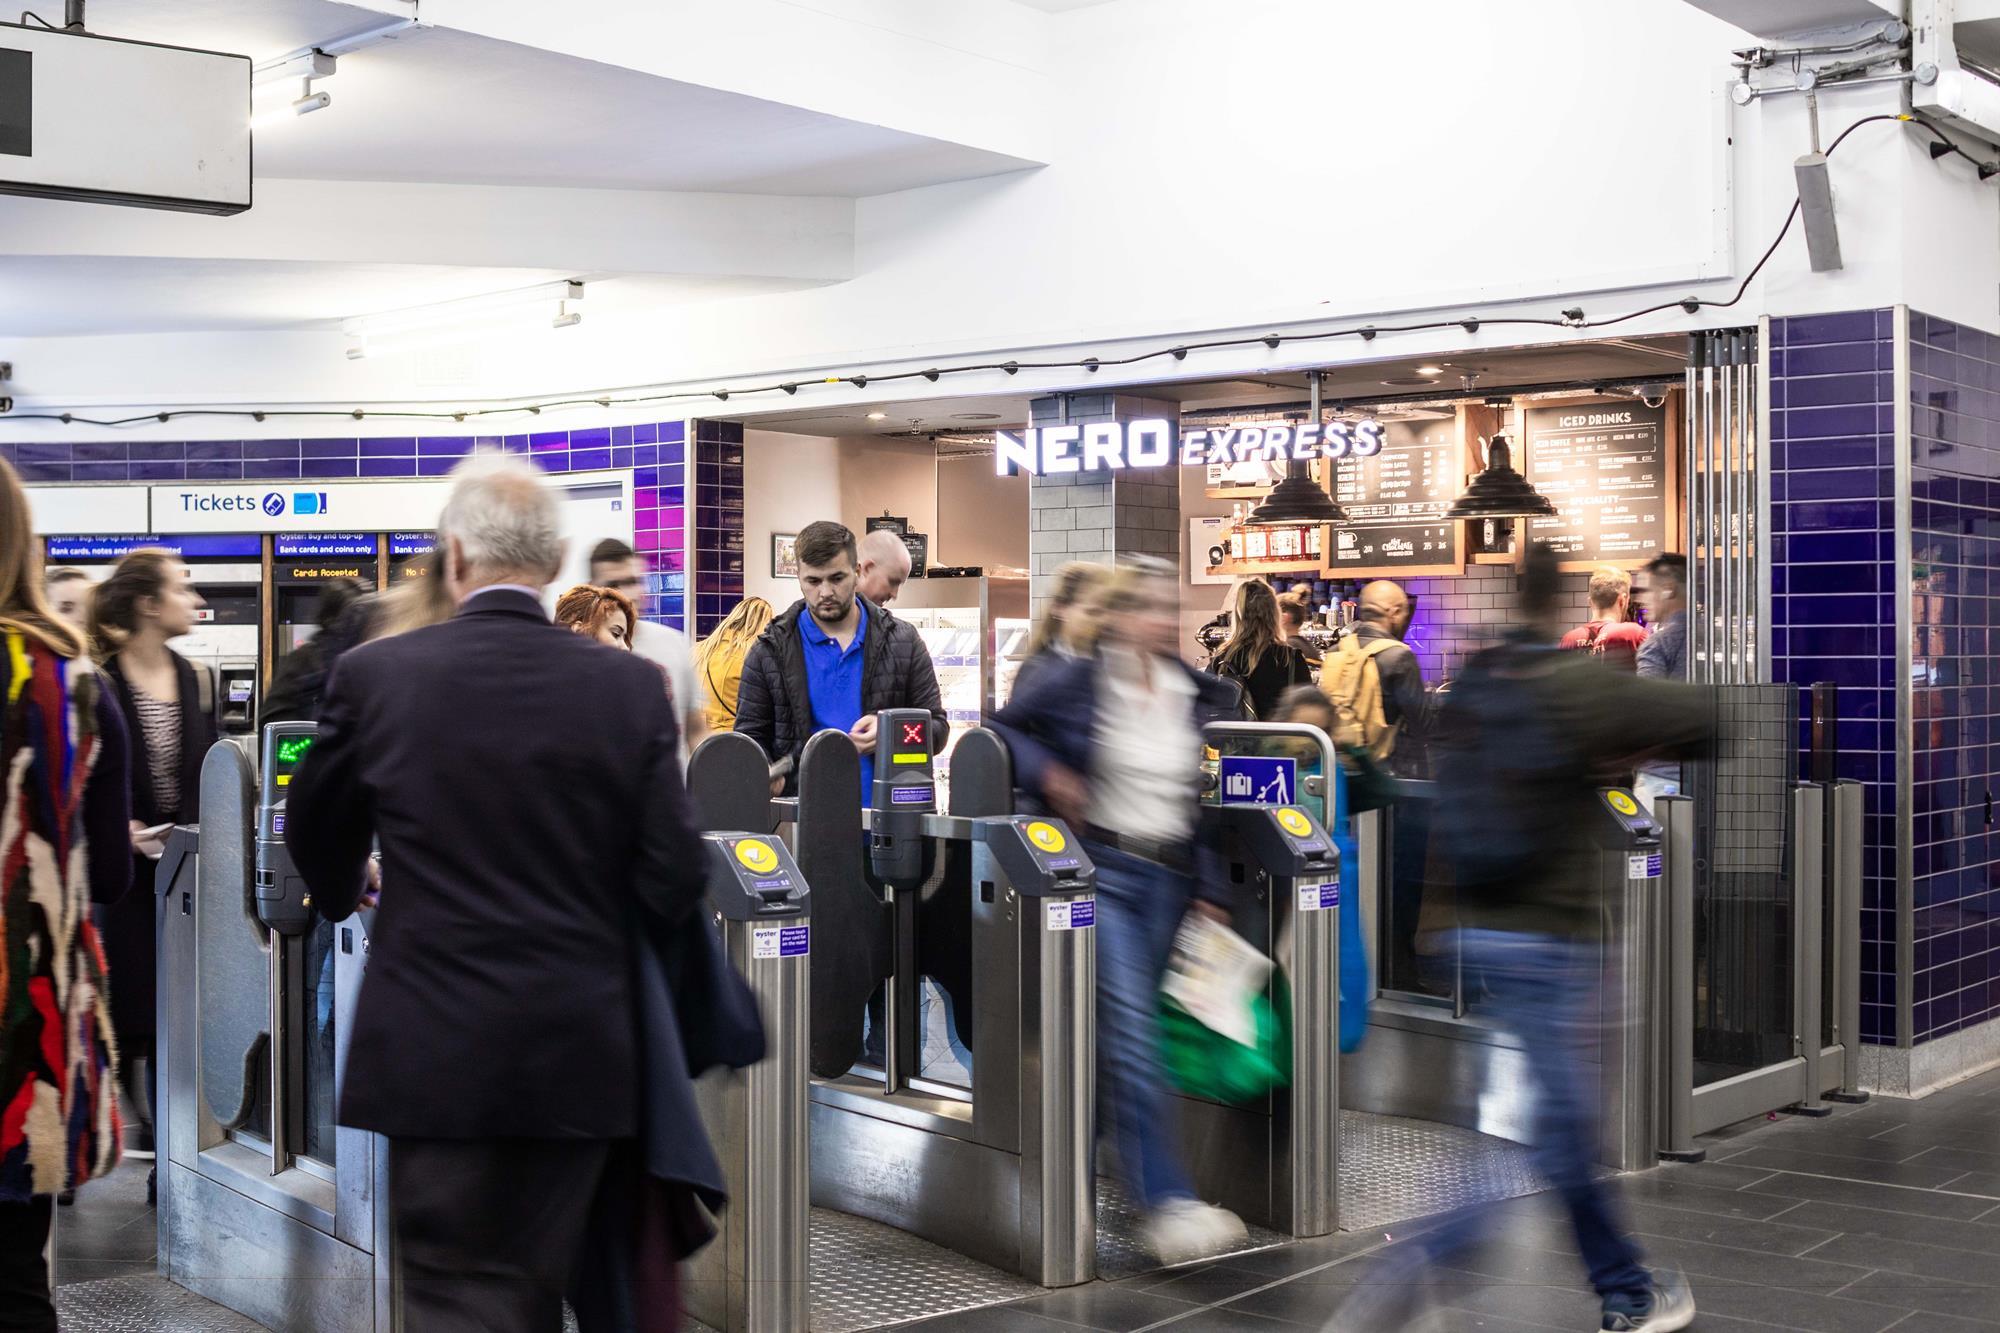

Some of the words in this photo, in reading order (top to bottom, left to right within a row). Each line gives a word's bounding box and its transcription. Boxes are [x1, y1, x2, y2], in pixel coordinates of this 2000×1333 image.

[1560, 416, 1585, 427] ICED
[1588, 412, 1631, 425] DRINKS
[996, 418, 1170, 476] NERO
[1181, 420, 1382, 465] EXPRESS
[180, 493, 256, 511] Tickets
[51, 547, 69, 555] Bank
[92, 547, 113, 555] notes
[356, 546, 372, 554] only
[395, 546, 413, 554] Bank
[293, 569, 318, 577] Cards
[321, 569, 359, 577] Accepted
[406, 569, 417, 577] No
[756, 930, 777, 939] oyster
